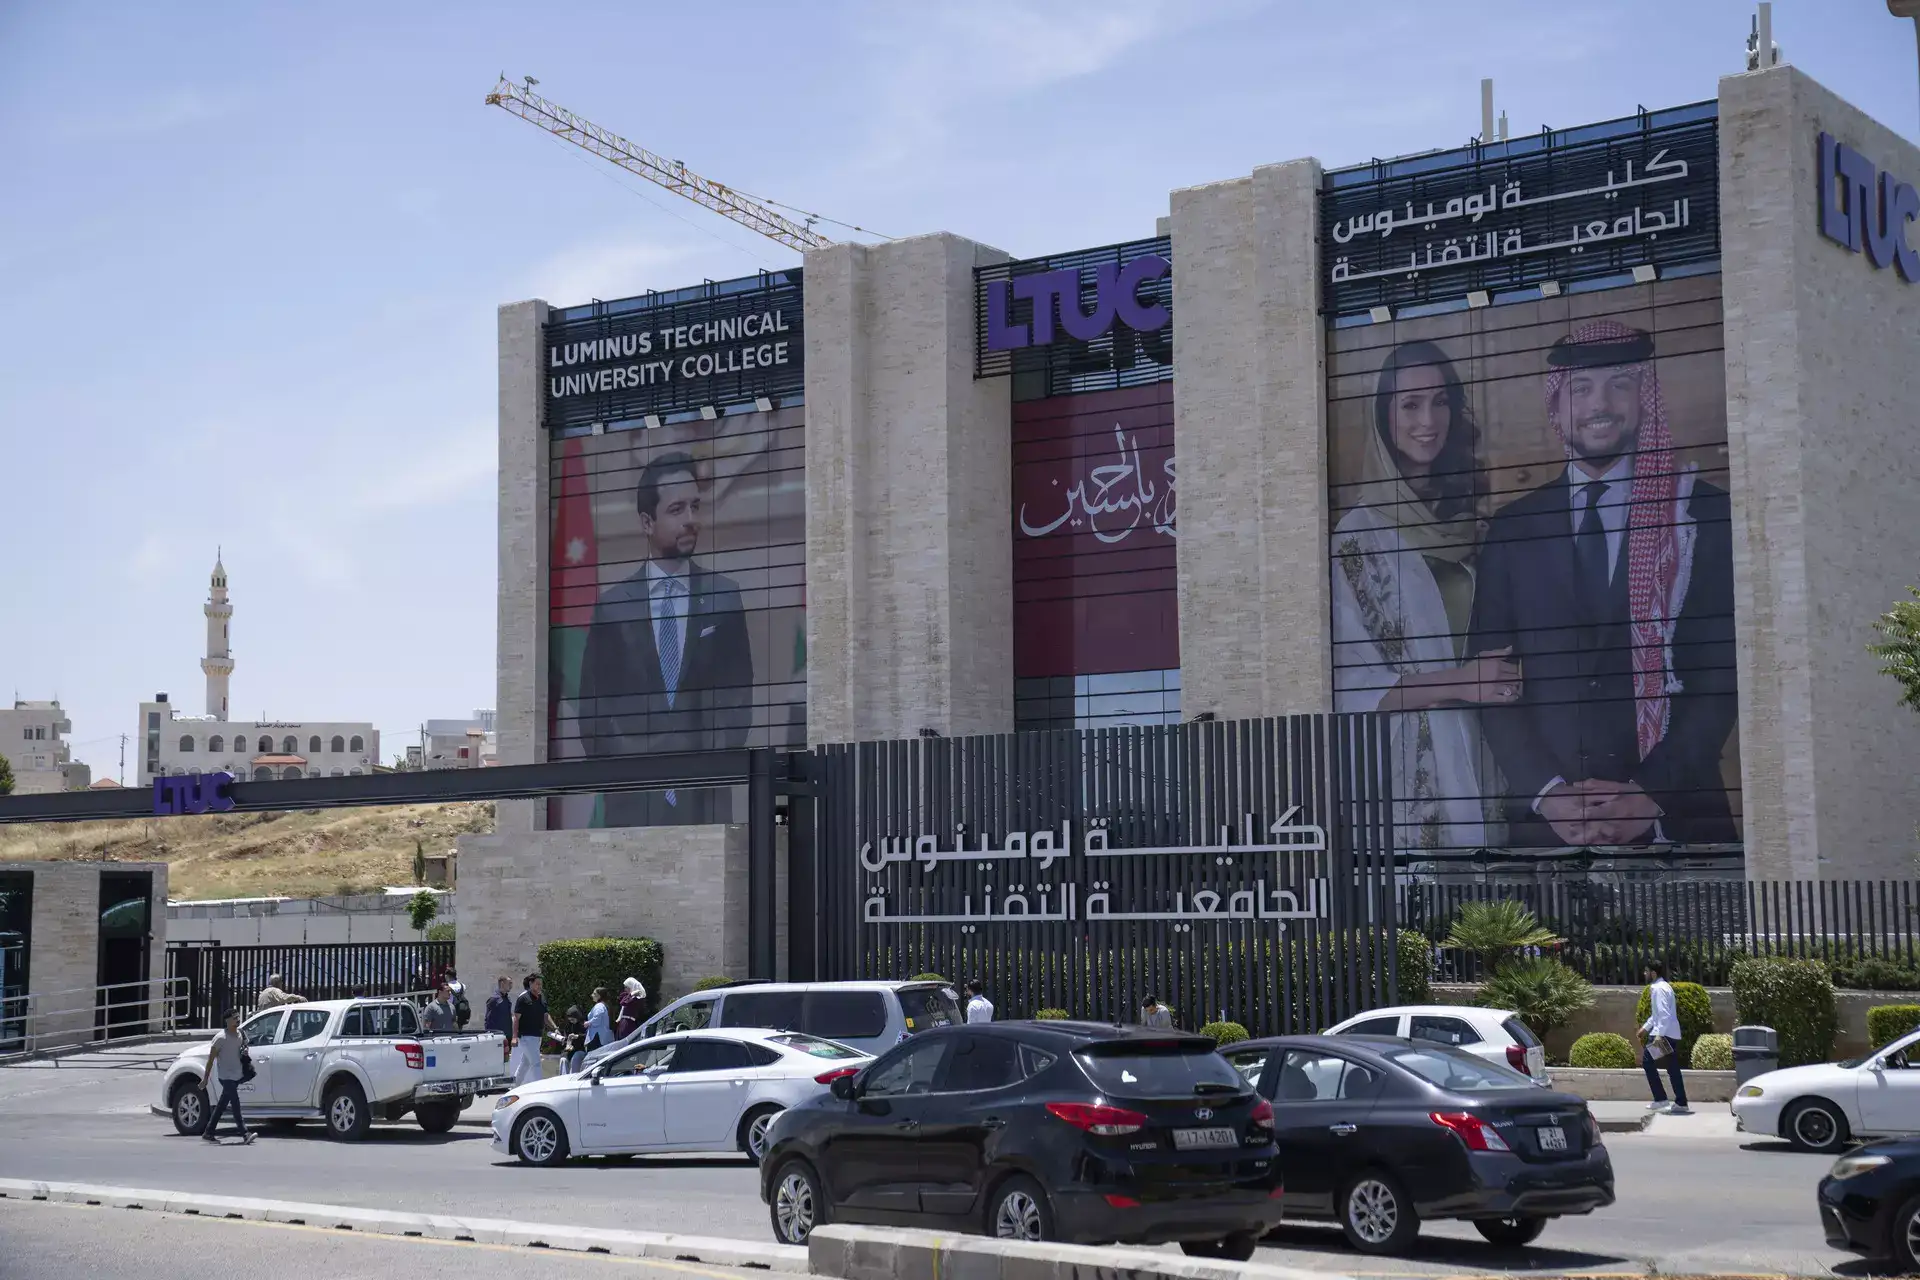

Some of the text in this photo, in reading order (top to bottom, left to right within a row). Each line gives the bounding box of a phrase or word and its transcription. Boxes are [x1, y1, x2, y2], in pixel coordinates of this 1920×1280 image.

[1332, 149, 1688, 243] كلية لومينوس
[1817, 132, 1920, 283] LTUC
[1332, 198, 1689, 283] الجامعية التقنية
[986, 254, 1172, 352] LTUC
[551, 310, 789, 367] LUMINUS TECHNICAL
[551, 341, 788, 398] UNIVERSITY COLLEGE
[153, 771, 236, 815] LTUC
[860, 805, 1326, 873] كلية لومينوس
[864, 877, 1327, 934] الجامعية التقنية
[1130, 1142, 1157, 1151] HYUNDAI
